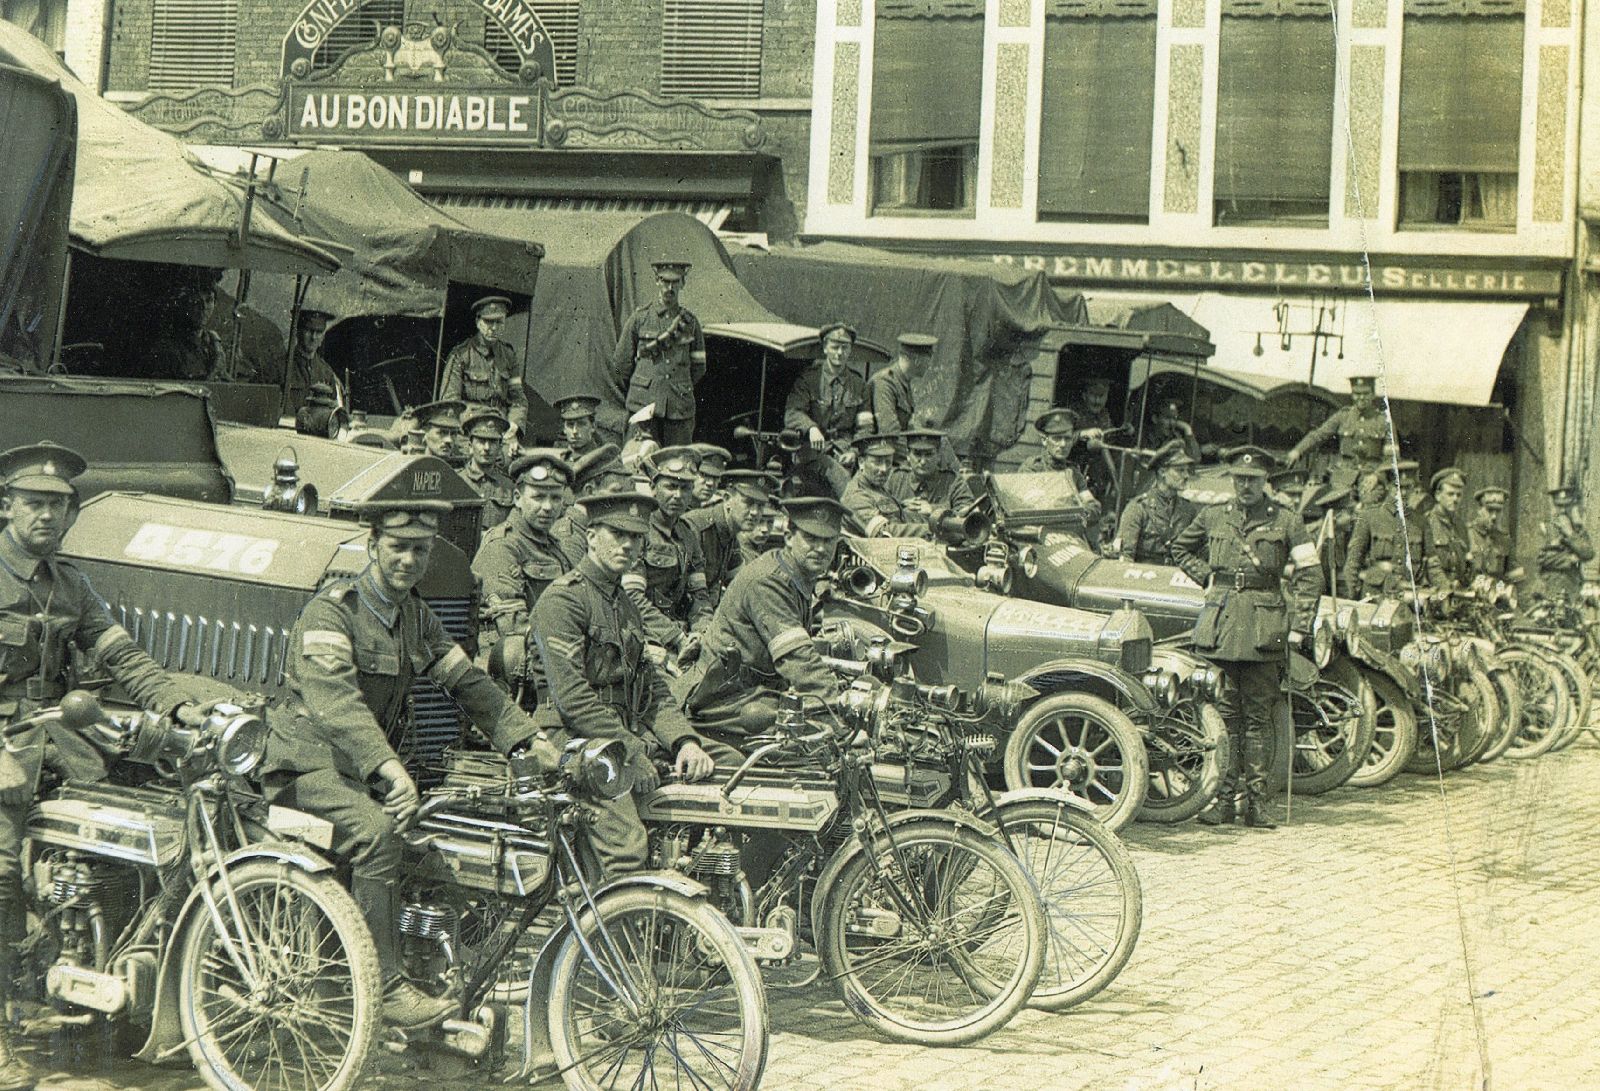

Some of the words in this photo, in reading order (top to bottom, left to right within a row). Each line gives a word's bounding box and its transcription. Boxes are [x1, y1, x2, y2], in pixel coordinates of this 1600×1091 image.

[300, 94, 340, 129] AU
[347, 95, 408, 130] BON
[415, 96, 530, 132] DIABLE
[412, 471, 443, 494] NAPIER
